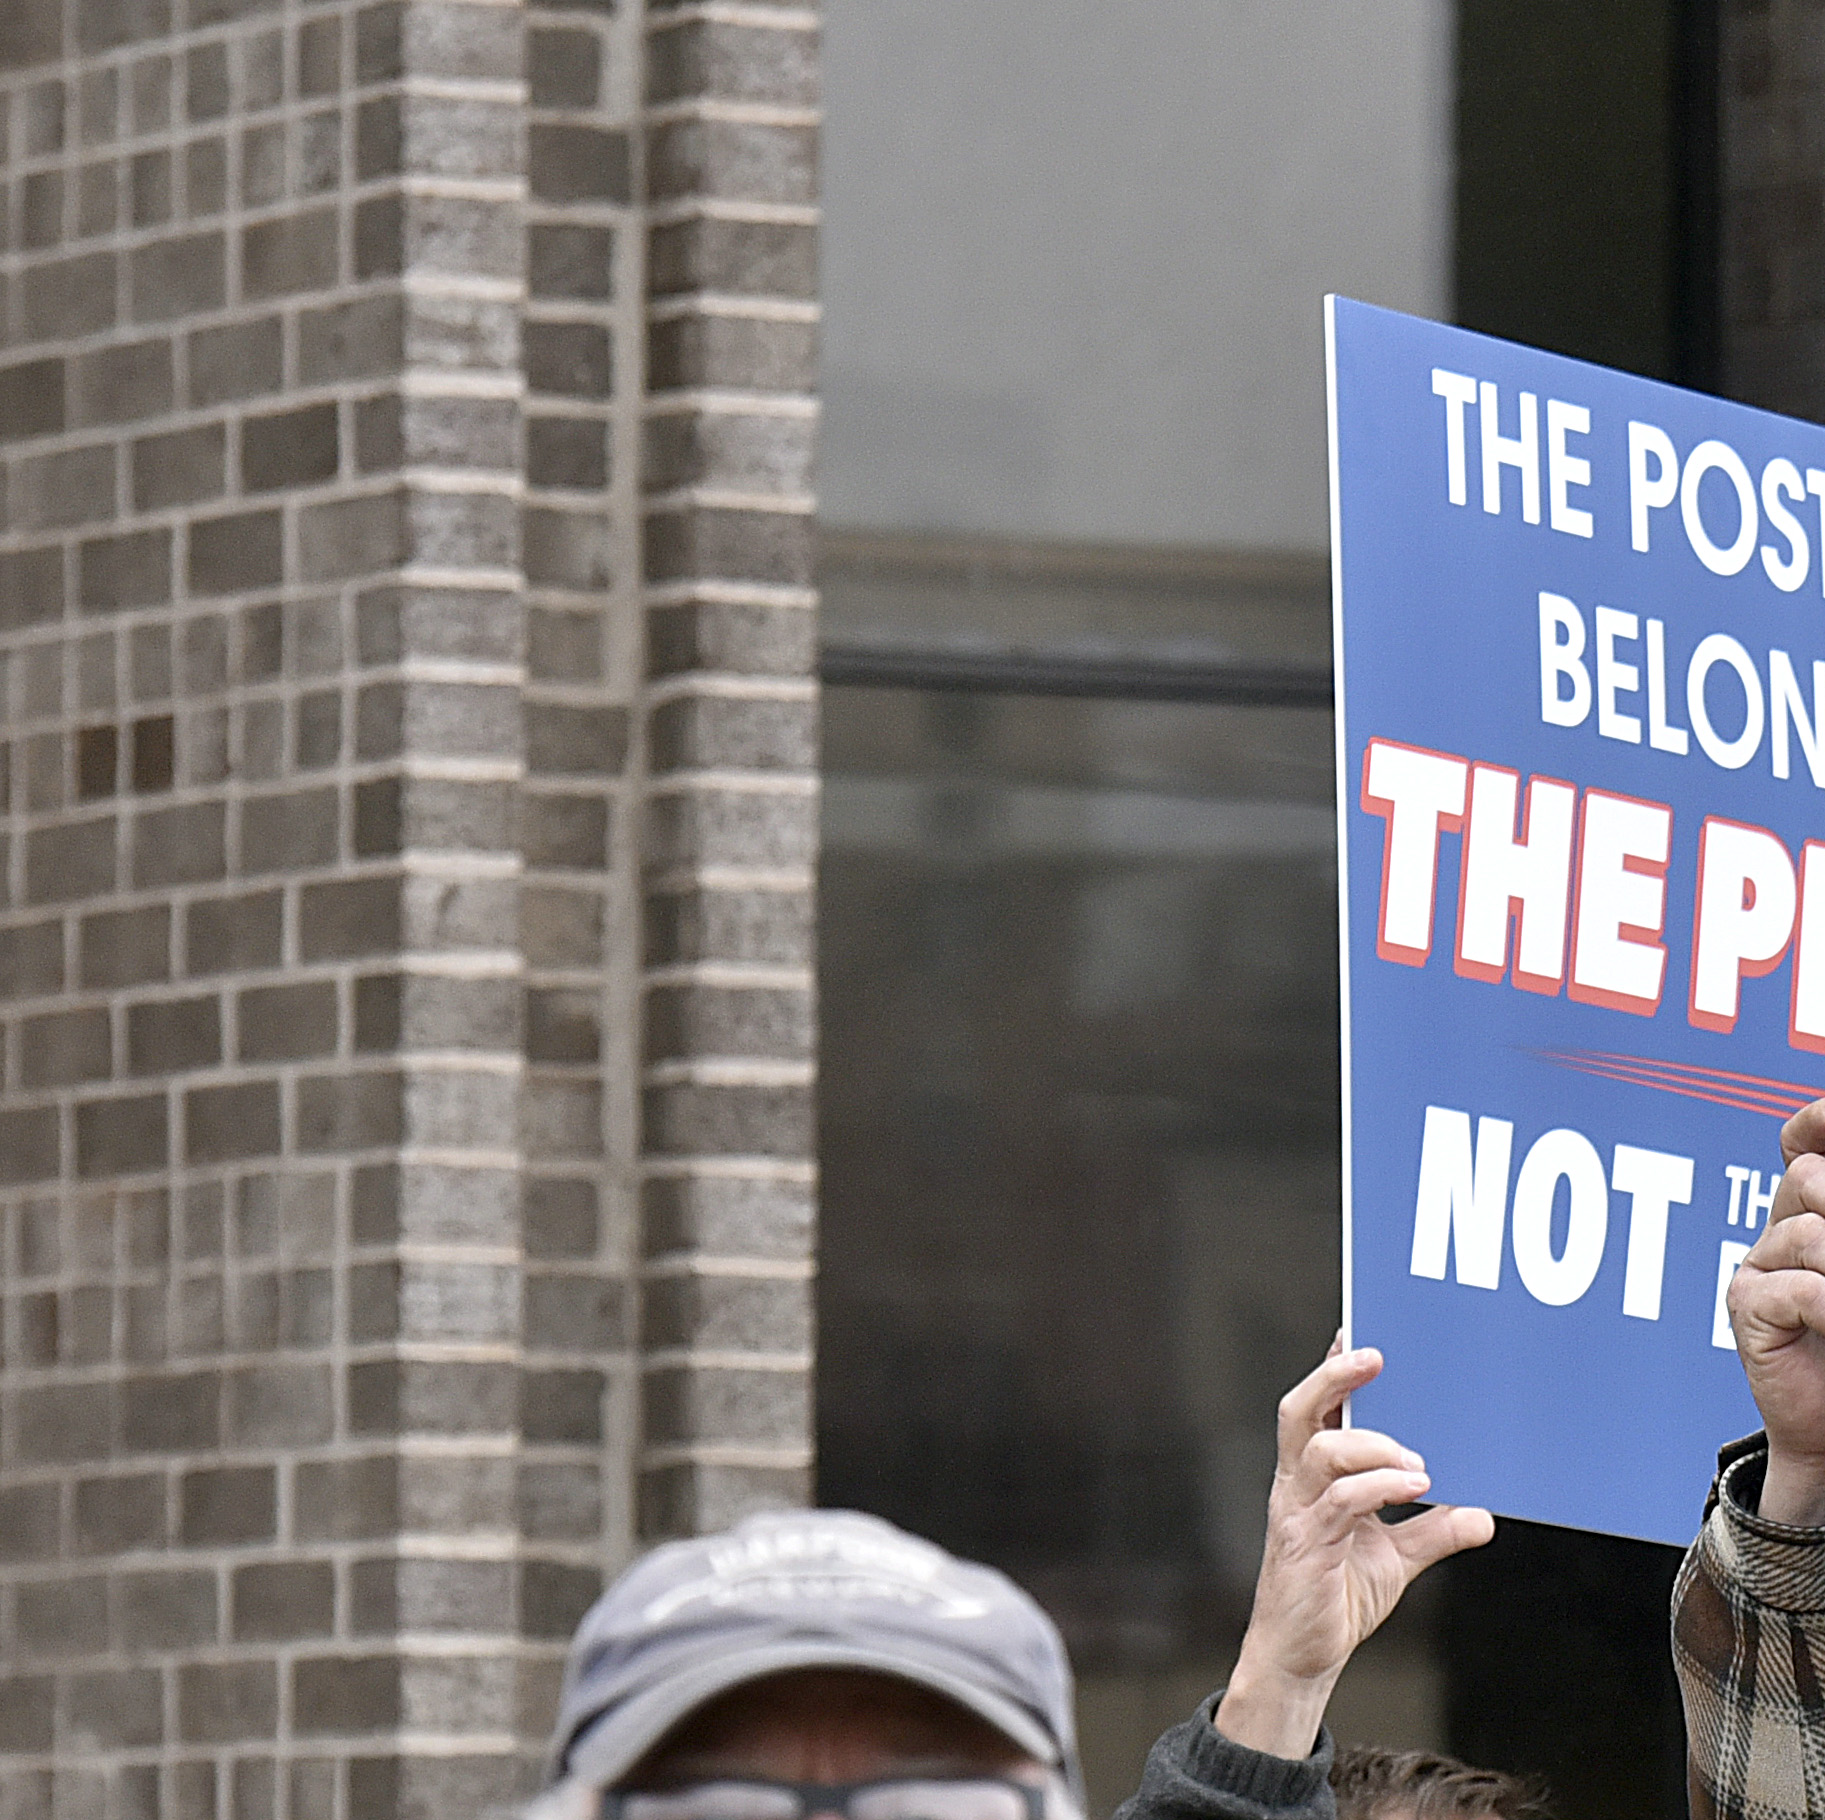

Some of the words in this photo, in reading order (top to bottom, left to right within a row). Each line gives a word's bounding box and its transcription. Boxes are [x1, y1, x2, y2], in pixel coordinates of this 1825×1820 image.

[1432, 368, 1593, 538] THE
[1360, 736, 1673, 1017] THE
[1410, 1106, 1694, 1320] NOT
